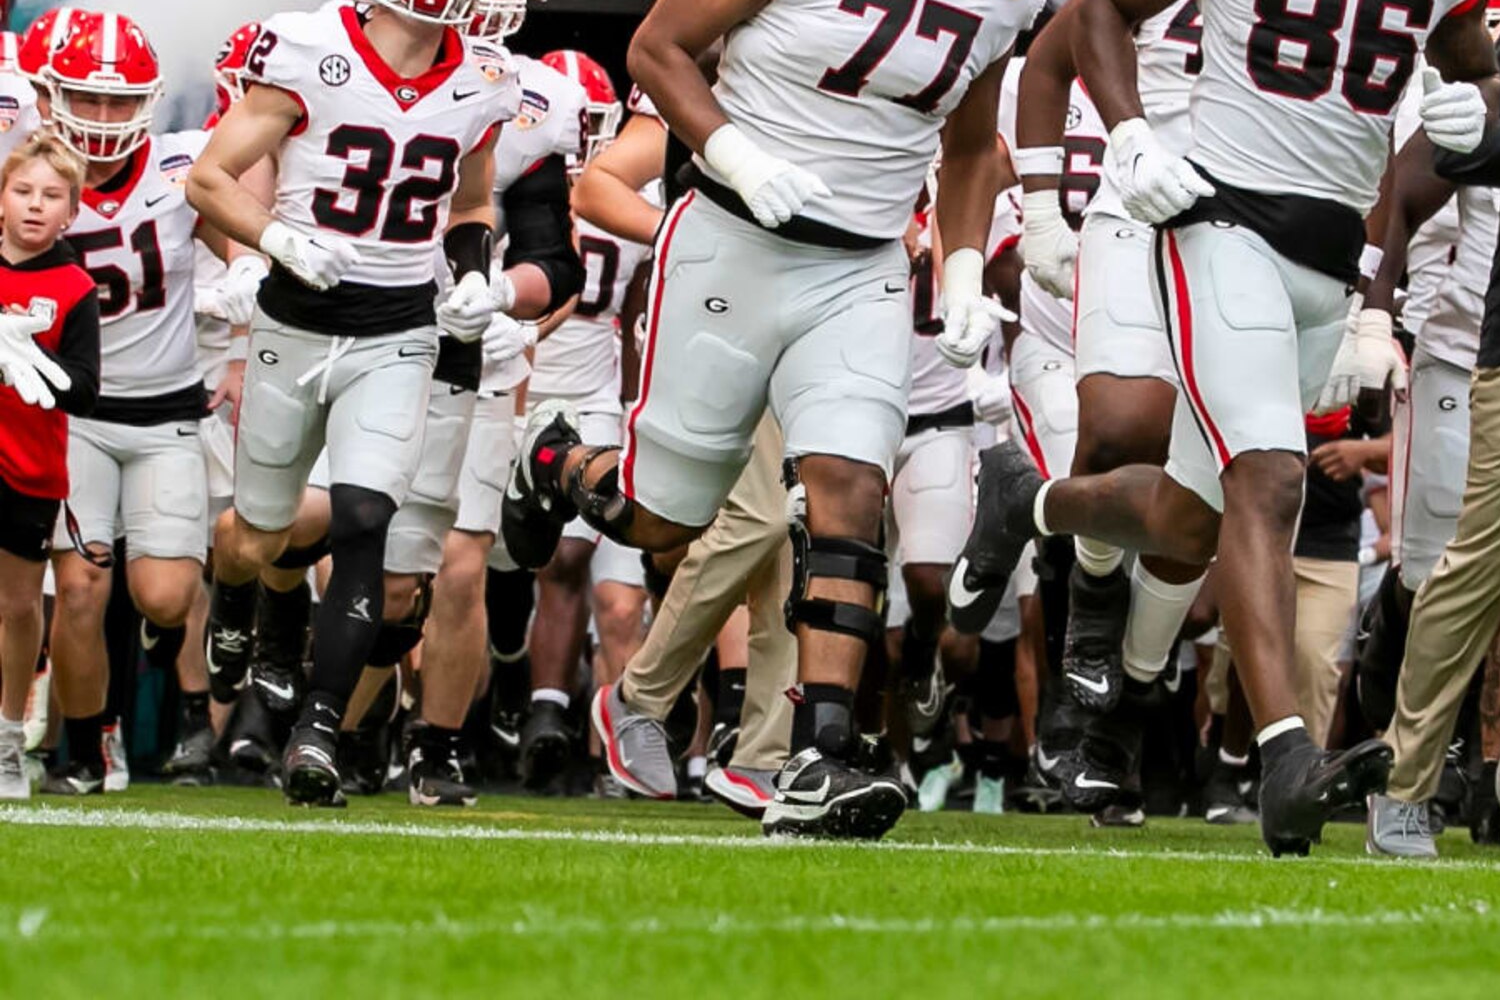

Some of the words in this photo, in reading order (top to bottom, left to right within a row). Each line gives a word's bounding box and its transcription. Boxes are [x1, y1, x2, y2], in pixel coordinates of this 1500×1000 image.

[320, 55, 350, 86] SEC
[311, 123, 460, 244] 32
[63, 220, 167, 318] 51
[704, 297, 729, 314] G
[258, 348, 280, 366] G
